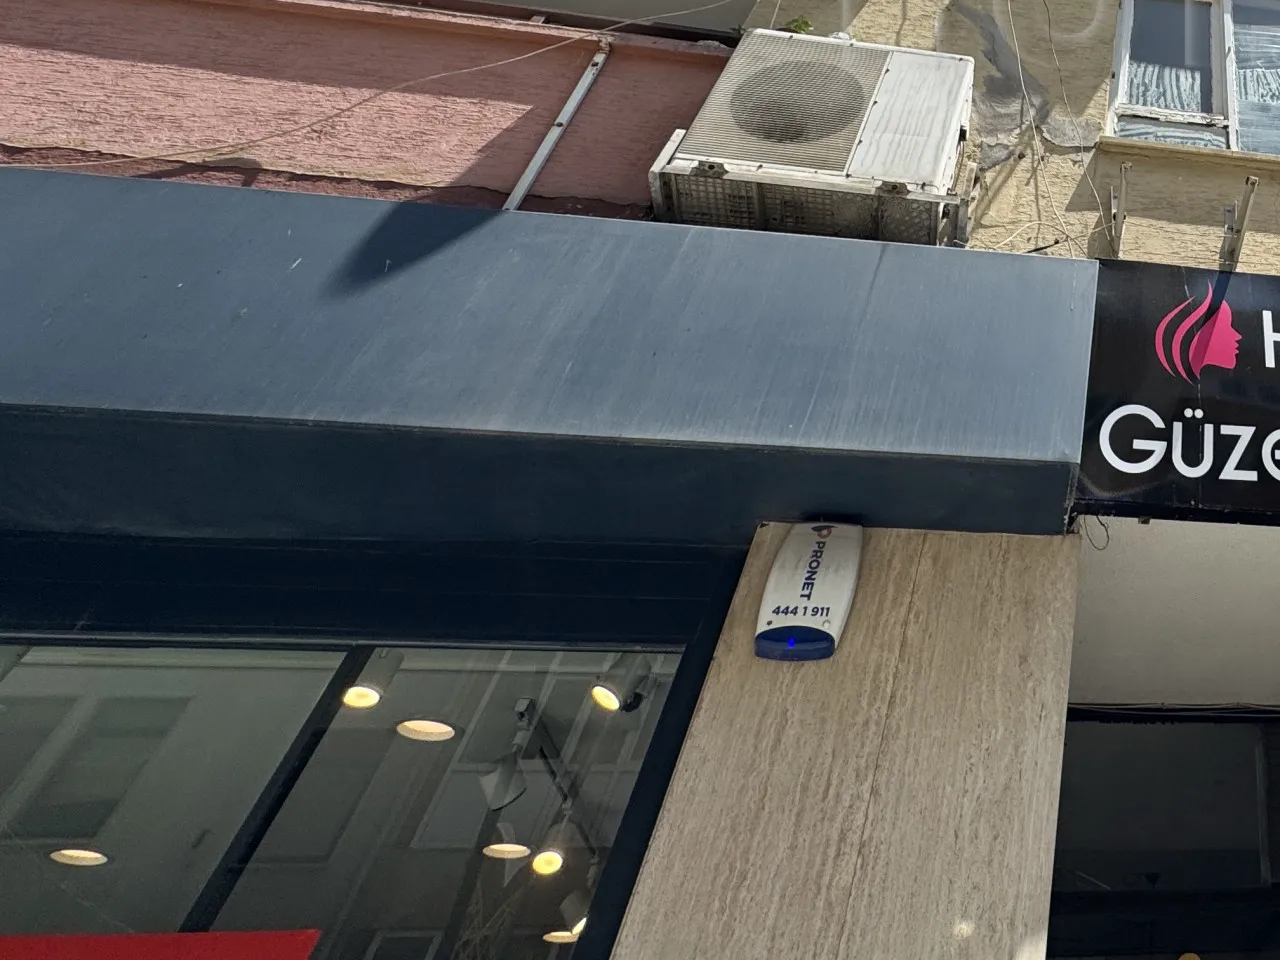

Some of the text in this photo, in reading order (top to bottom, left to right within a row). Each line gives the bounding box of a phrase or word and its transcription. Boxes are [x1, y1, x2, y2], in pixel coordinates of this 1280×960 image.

[799, 541, 827, 601] PRONET
[771, 605, 831, 618] 444 1 911
